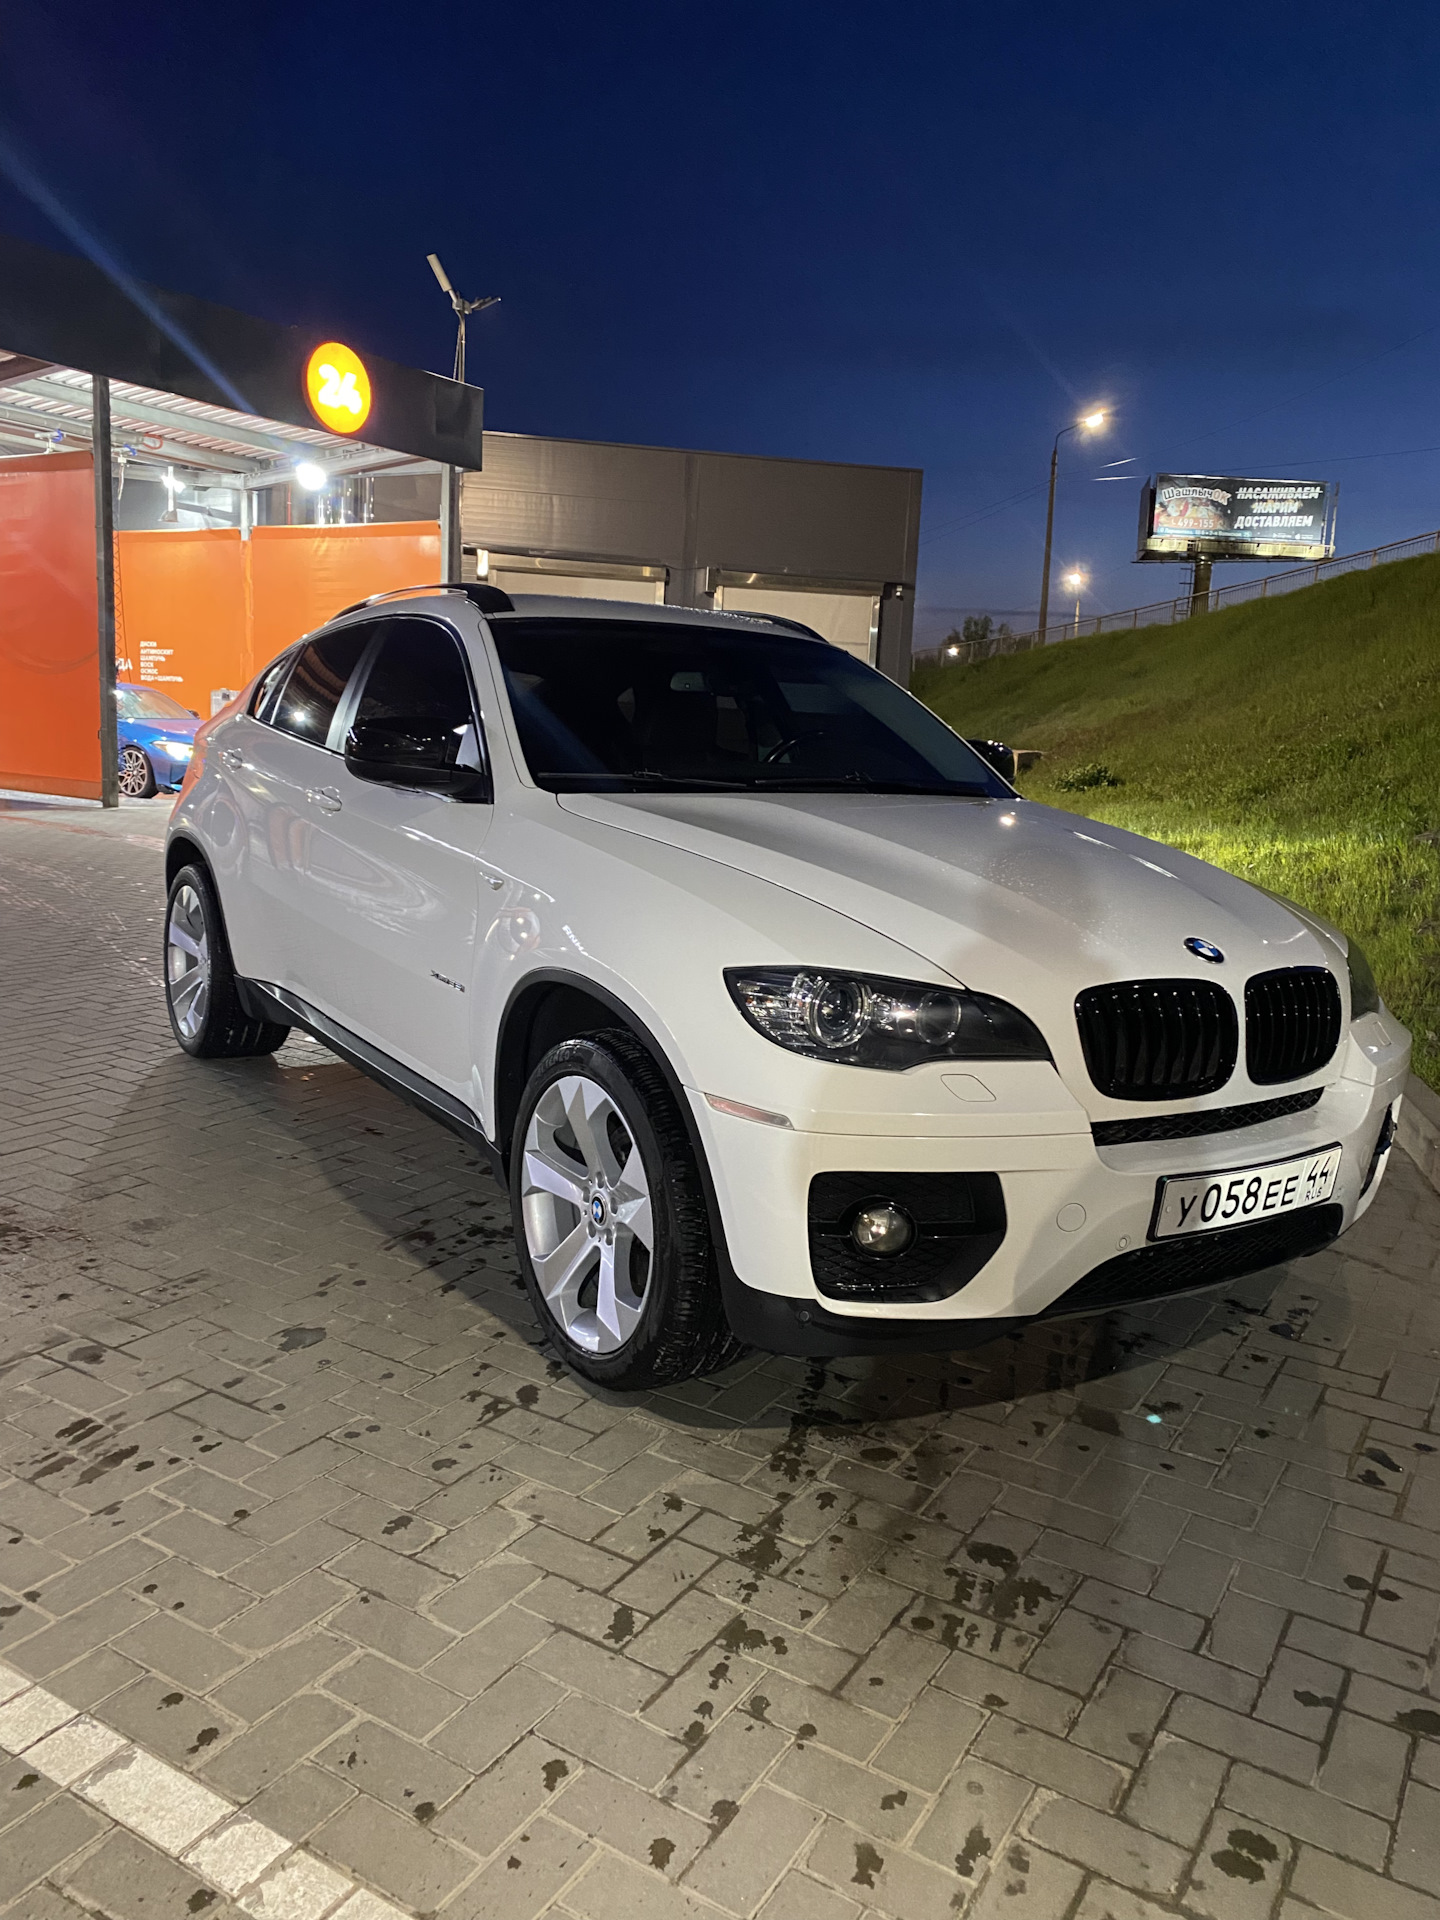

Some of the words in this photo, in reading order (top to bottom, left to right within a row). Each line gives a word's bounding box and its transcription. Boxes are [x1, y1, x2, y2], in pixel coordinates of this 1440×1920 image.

[318, 363, 363, 415] 24
[1236, 486, 1321, 500] НАСАЖИВАЕМ
[1252, 501, 1298, 514] ЖАРИМ
[1177, 518, 1214, 528] 499-155
[1234, 515, 1314, 529] ДОСТАВЛЯЕМ
[1306, 1156, 1332, 1189] 44
[1304, 1187, 1322, 1202] RUS
